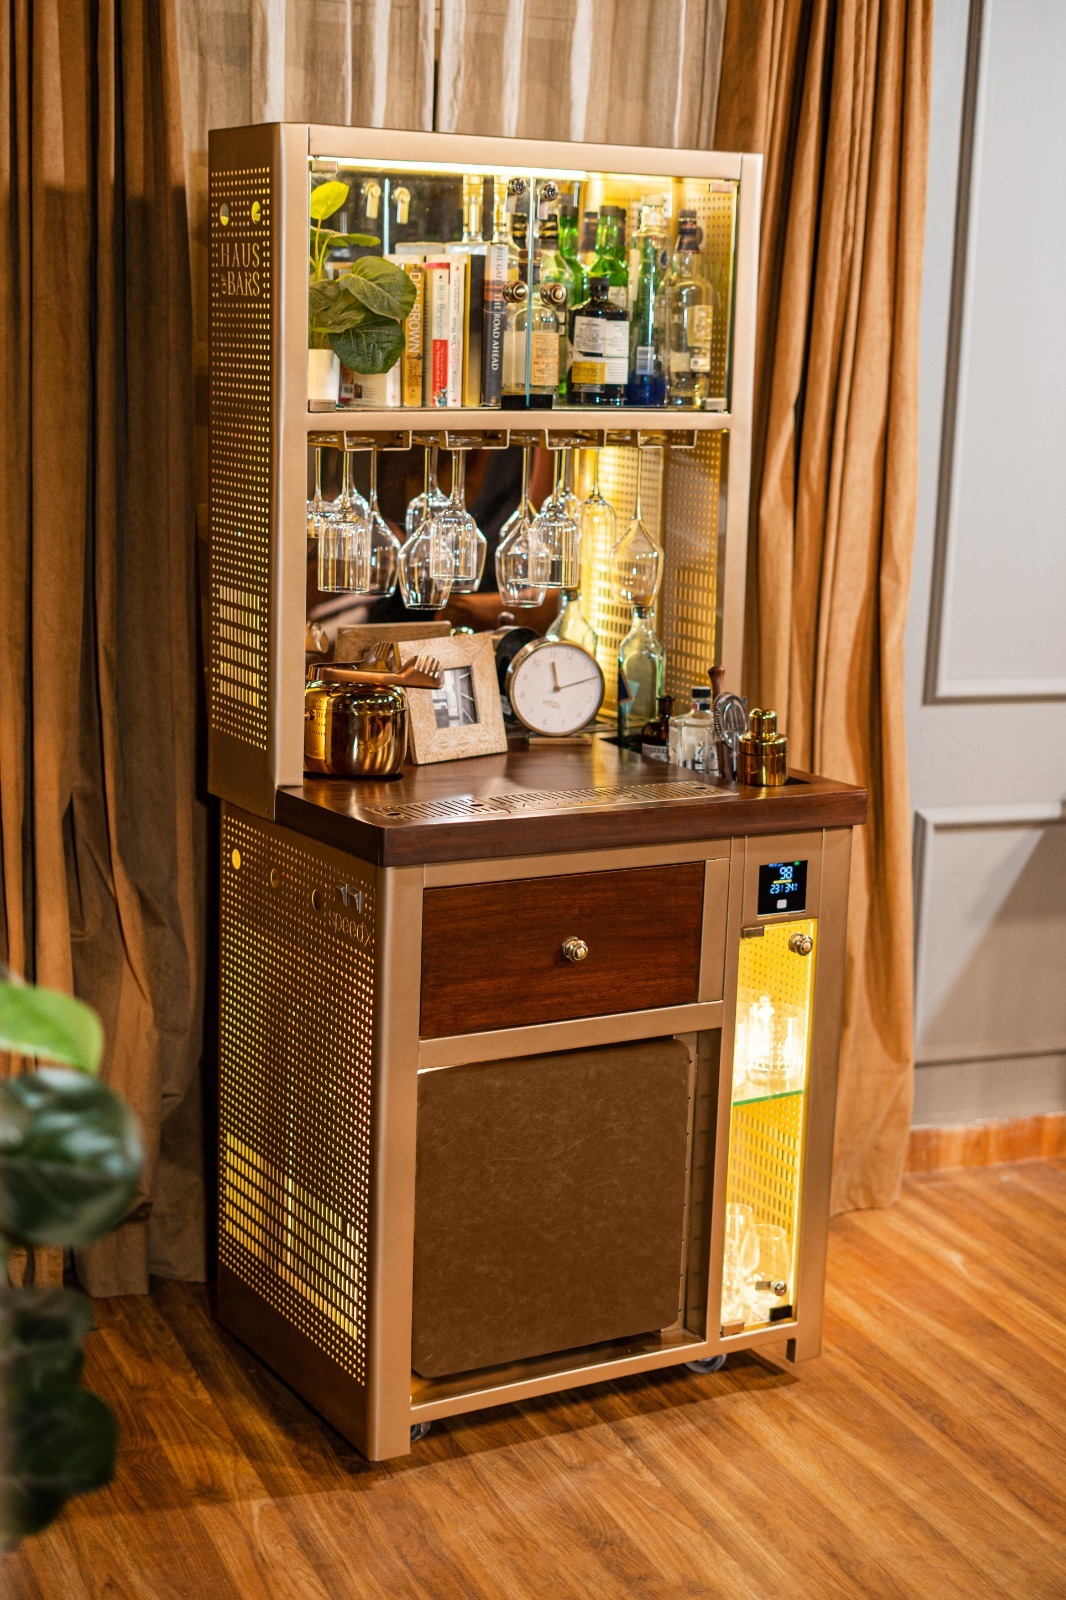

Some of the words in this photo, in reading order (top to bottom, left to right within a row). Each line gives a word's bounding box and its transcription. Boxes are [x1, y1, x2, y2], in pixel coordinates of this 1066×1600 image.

[220, 242, 260, 268] HAUS
[227, 270, 260, 297] BARS
[437, 284, 445, 302] Bill
[493, 293, 501, 311] THE
[408, 304, 421, 353] BROWN
[436, 303, 445, 338] Bryson
[492, 313, 500, 339] ROAD
[491, 340, 500, 371] AHEAD
[779, 865, 793, 880] 98
[770, 884, 780, 894] 23
[785, 882, 794, 893] 34
[328, 910, 372, 947] speedx
